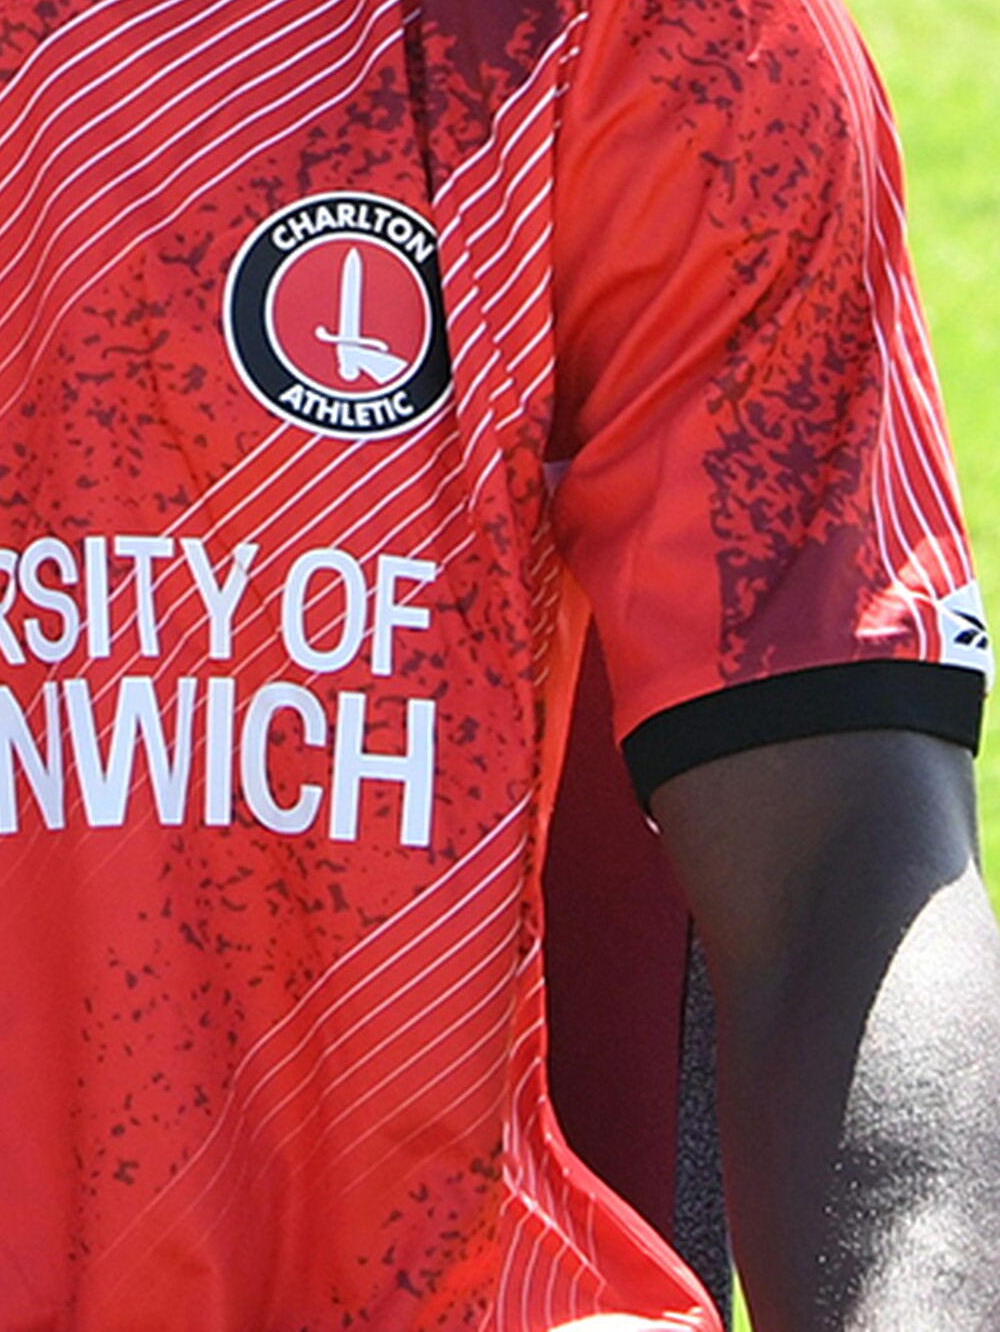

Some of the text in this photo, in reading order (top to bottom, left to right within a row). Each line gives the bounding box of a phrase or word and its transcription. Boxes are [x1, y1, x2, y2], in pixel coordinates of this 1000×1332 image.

[272, 203, 435, 264] CHARLTON
[278, 383, 415, 427] ATHLETIC
[281, 547, 438, 676] OF
